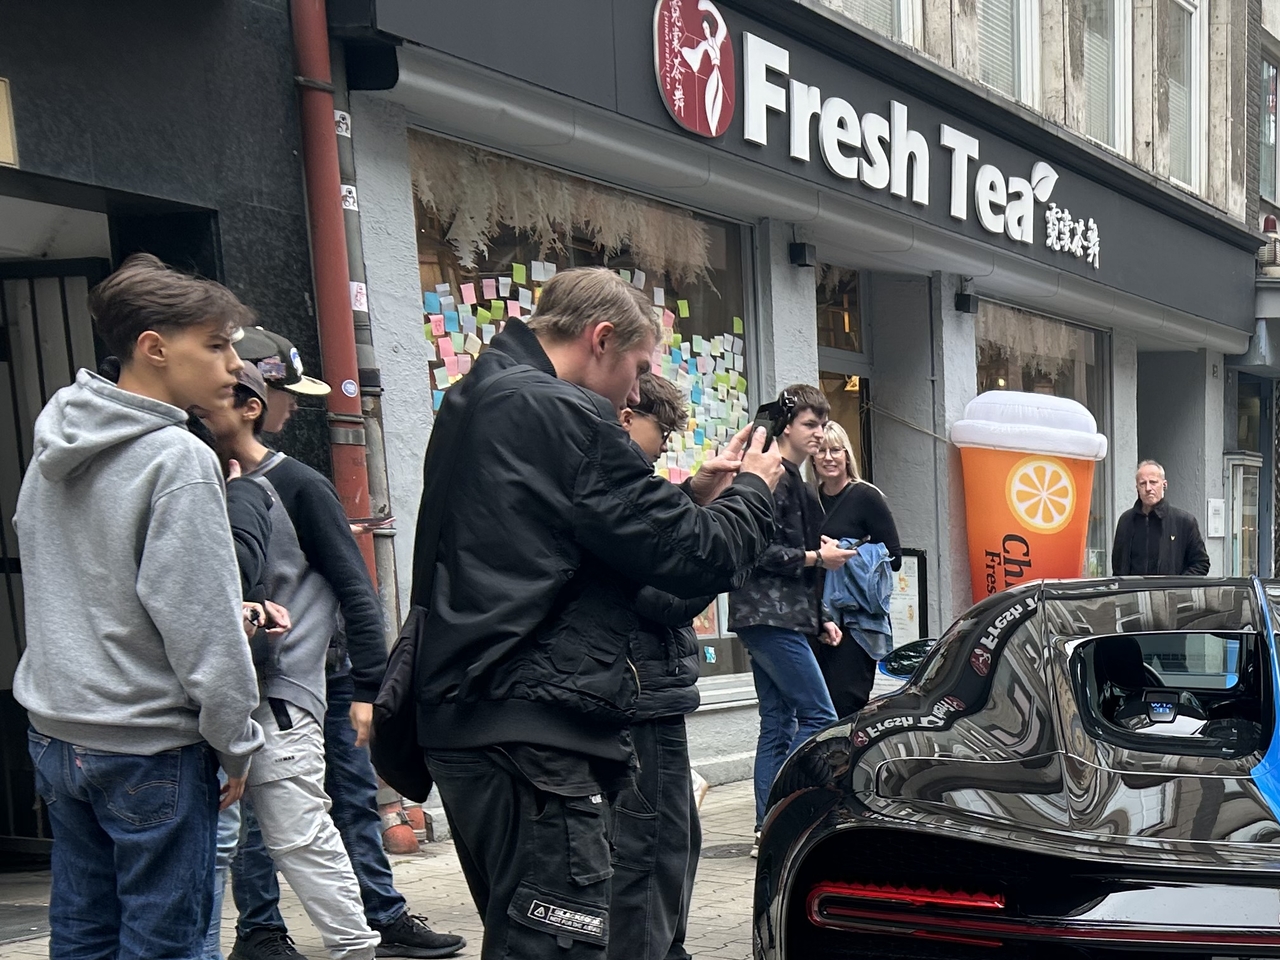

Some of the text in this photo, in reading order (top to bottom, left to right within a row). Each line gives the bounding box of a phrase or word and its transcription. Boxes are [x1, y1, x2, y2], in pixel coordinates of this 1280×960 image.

[743, 31, 1034, 244] Fresh Tea
[984, 549, 1002, 597] Fres
[1002, 533, 1031, 588] Ch
